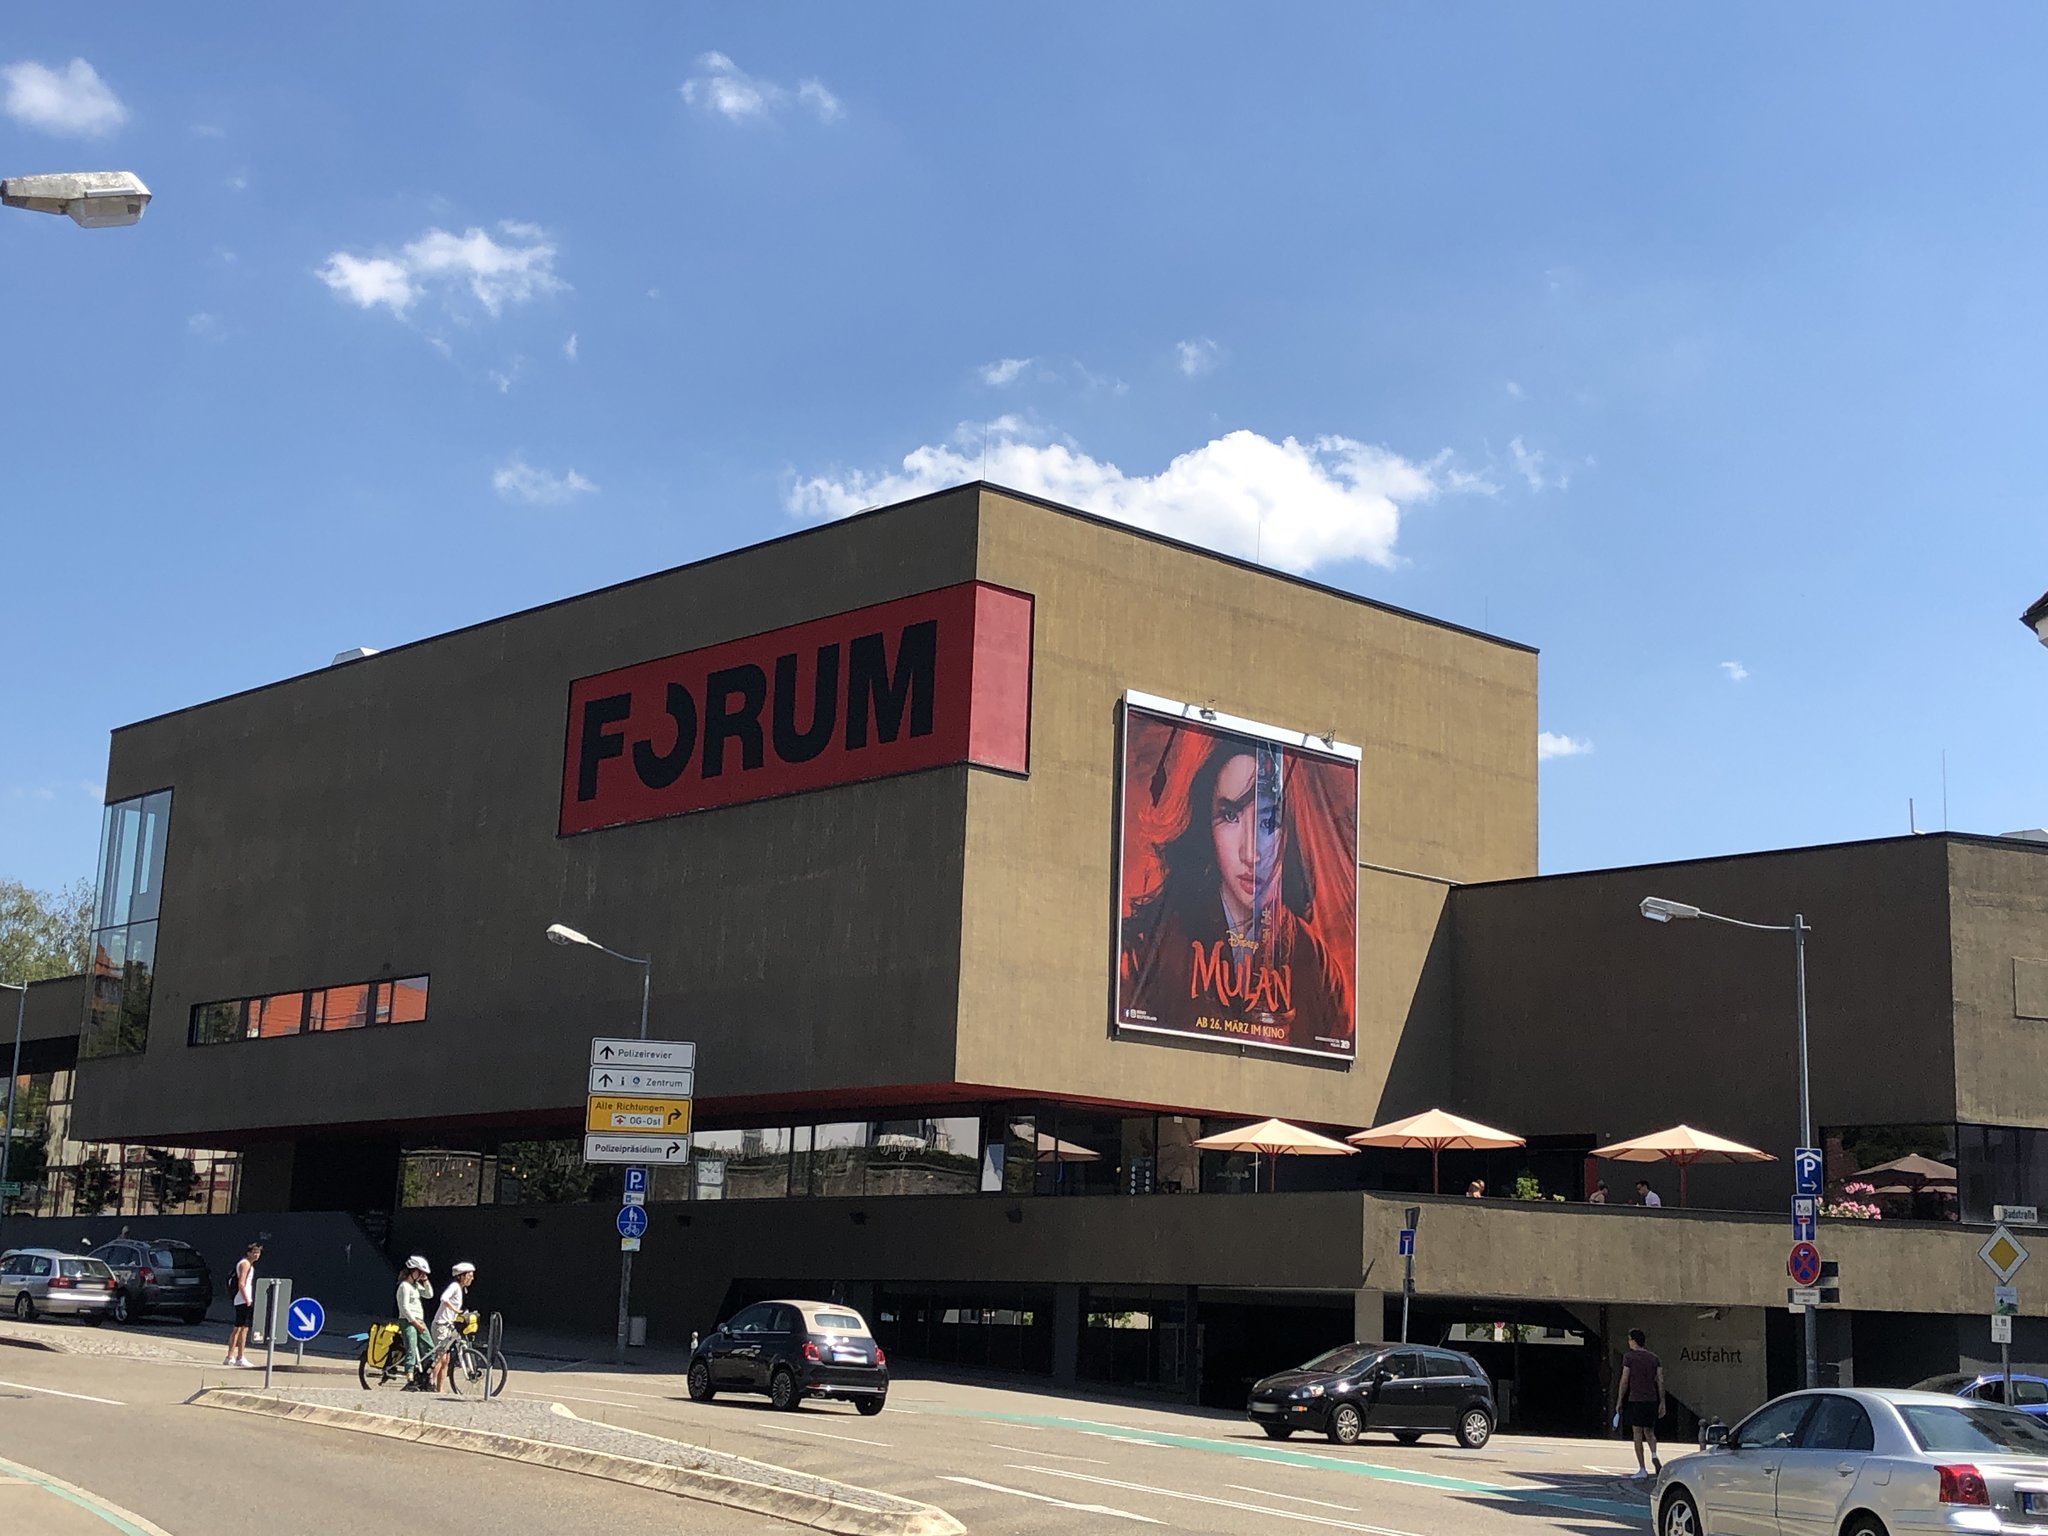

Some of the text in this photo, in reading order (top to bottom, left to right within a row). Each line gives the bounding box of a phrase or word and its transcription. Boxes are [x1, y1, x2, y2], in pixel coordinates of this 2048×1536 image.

[578, 620, 938, 801] FORUM
[1191, 940, 1293, 1014] MULAN
[1195, 1016, 1285, 1040] AB 26. MÄRZ IM KINO
[618, 1048, 673, 1060] Polizeirevier
[646, 1078, 683, 1088] Zentrum
[595, 1101, 665, 1114] Alle Richtungen
[629, 1116, 661, 1126] OG-Ost
[595, 1143, 663, 1155] Polizeipräsidium
[1803, 1158, 1816, 1178] P
[630, 1171, 642, 1190] P
[1680, 1346, 1742, 1363] Ausfahrt
